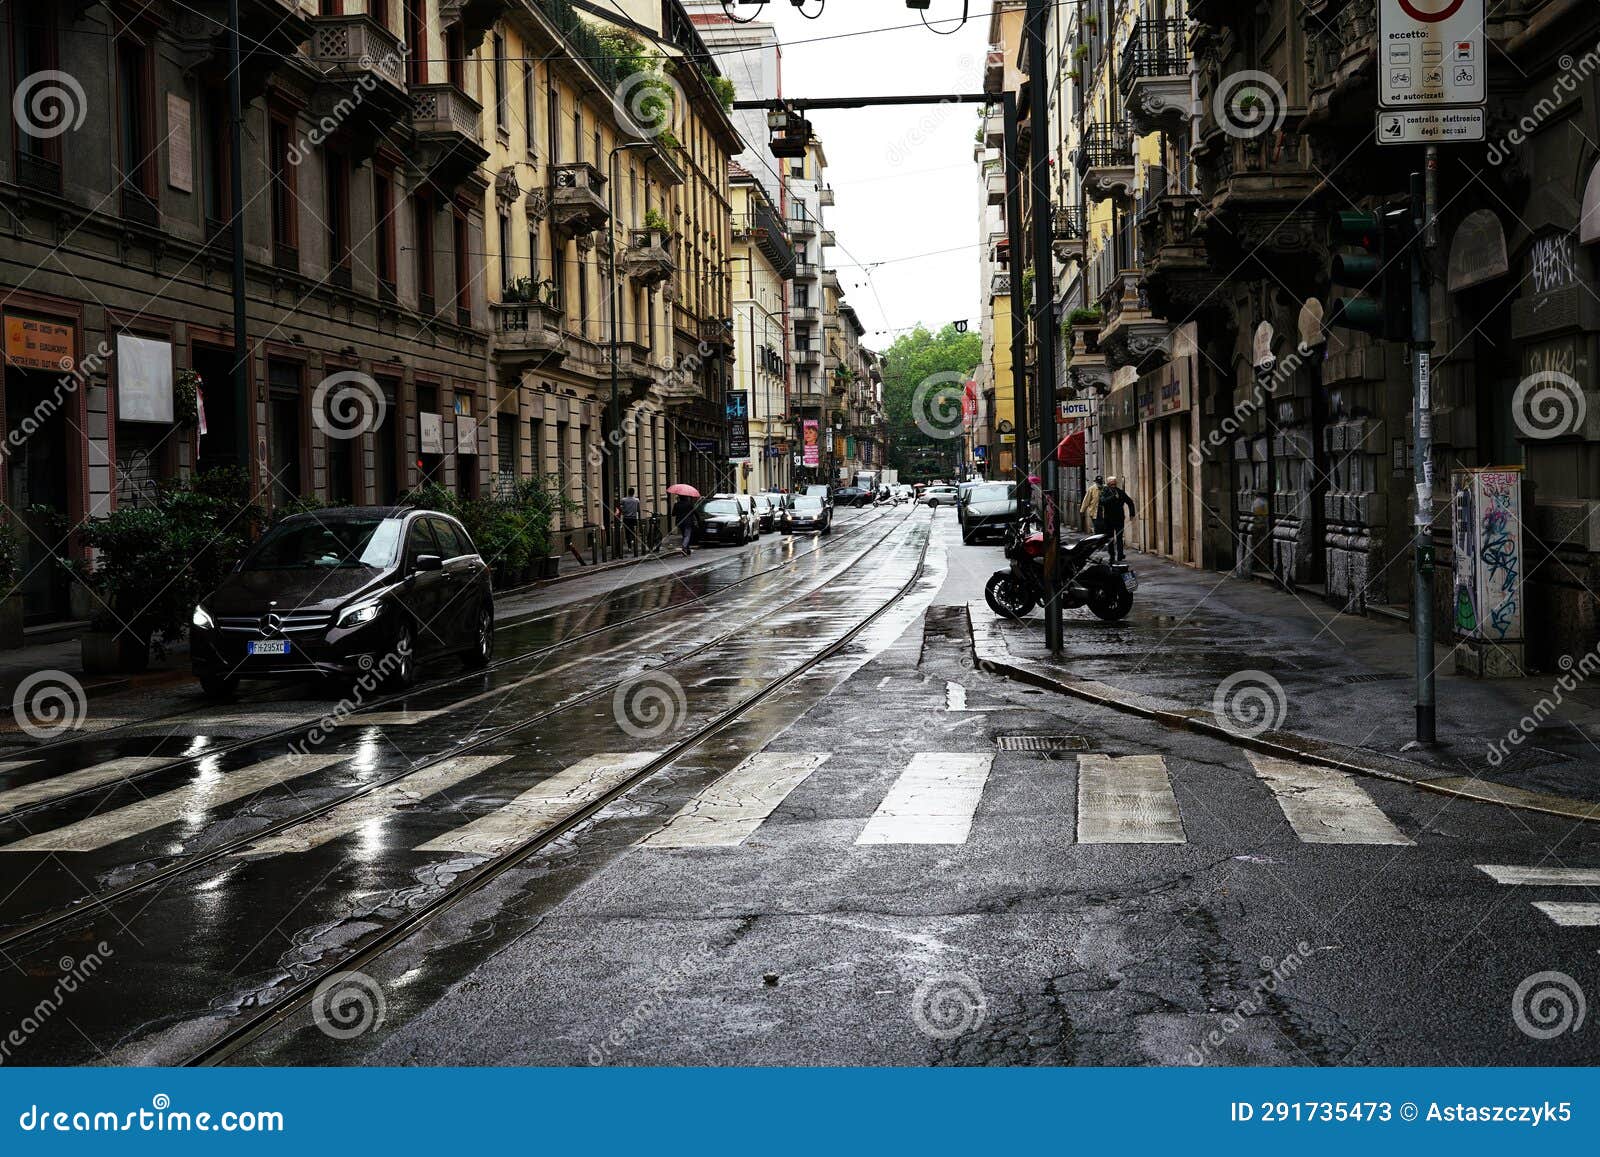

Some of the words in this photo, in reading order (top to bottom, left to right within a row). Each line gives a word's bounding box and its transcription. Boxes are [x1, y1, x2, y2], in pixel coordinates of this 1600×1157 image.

[1389, 30, 1429, 39] eccetto:
[1403, 92, 1444, 100] autorizzati
[1406, 115, 1439, 124] controllo
[1421, 128, 1438, 136] degli
[1063, 405, 1088, 413] HOTEL
